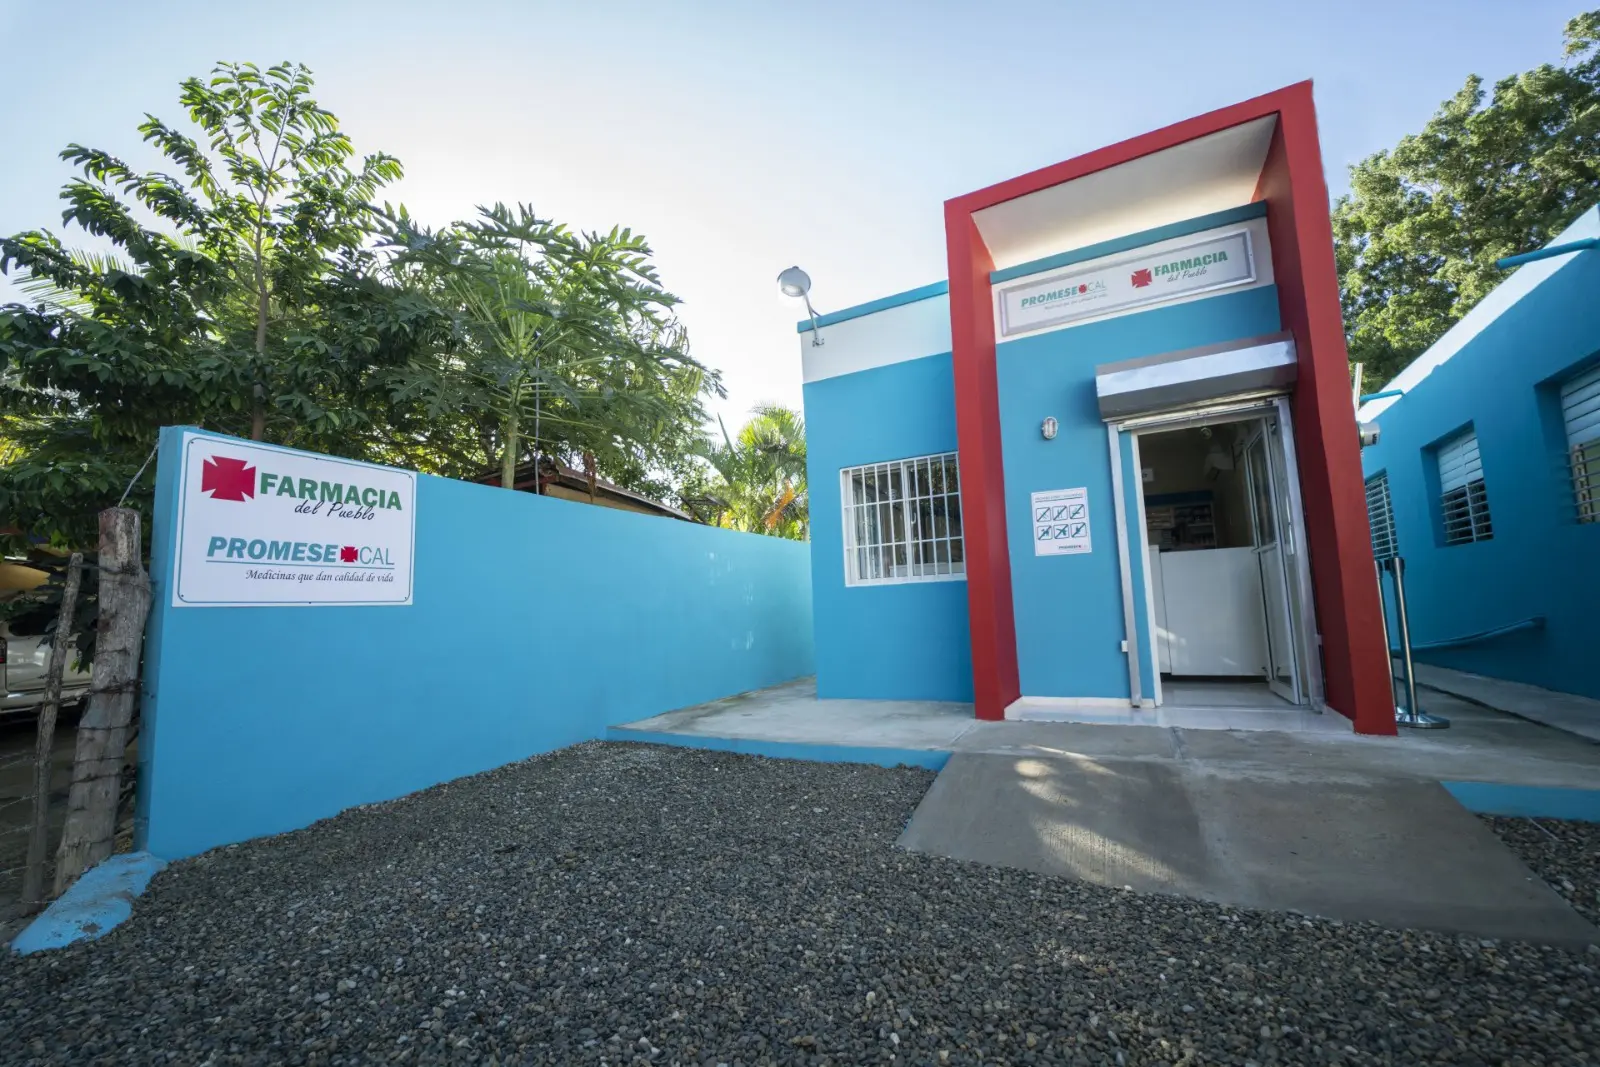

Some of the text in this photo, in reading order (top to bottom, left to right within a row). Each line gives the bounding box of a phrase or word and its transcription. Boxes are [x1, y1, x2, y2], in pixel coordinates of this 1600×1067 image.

[1154, 251, 1228, 276] FARMACIA
[1167, 266, 1207, 283] del Pueblo
[1021, 286, 1078, 307] PROMESE
[1088, 280, 1106, 291] CAL
[260, 472, 402, 510] FARMACIA
[294, 500, 375, 520] del Pueblo
[207, 536, 395, 565] PROMESE CAL
[245, 569, 394, 583] Medicinas que dan calidad de vida
